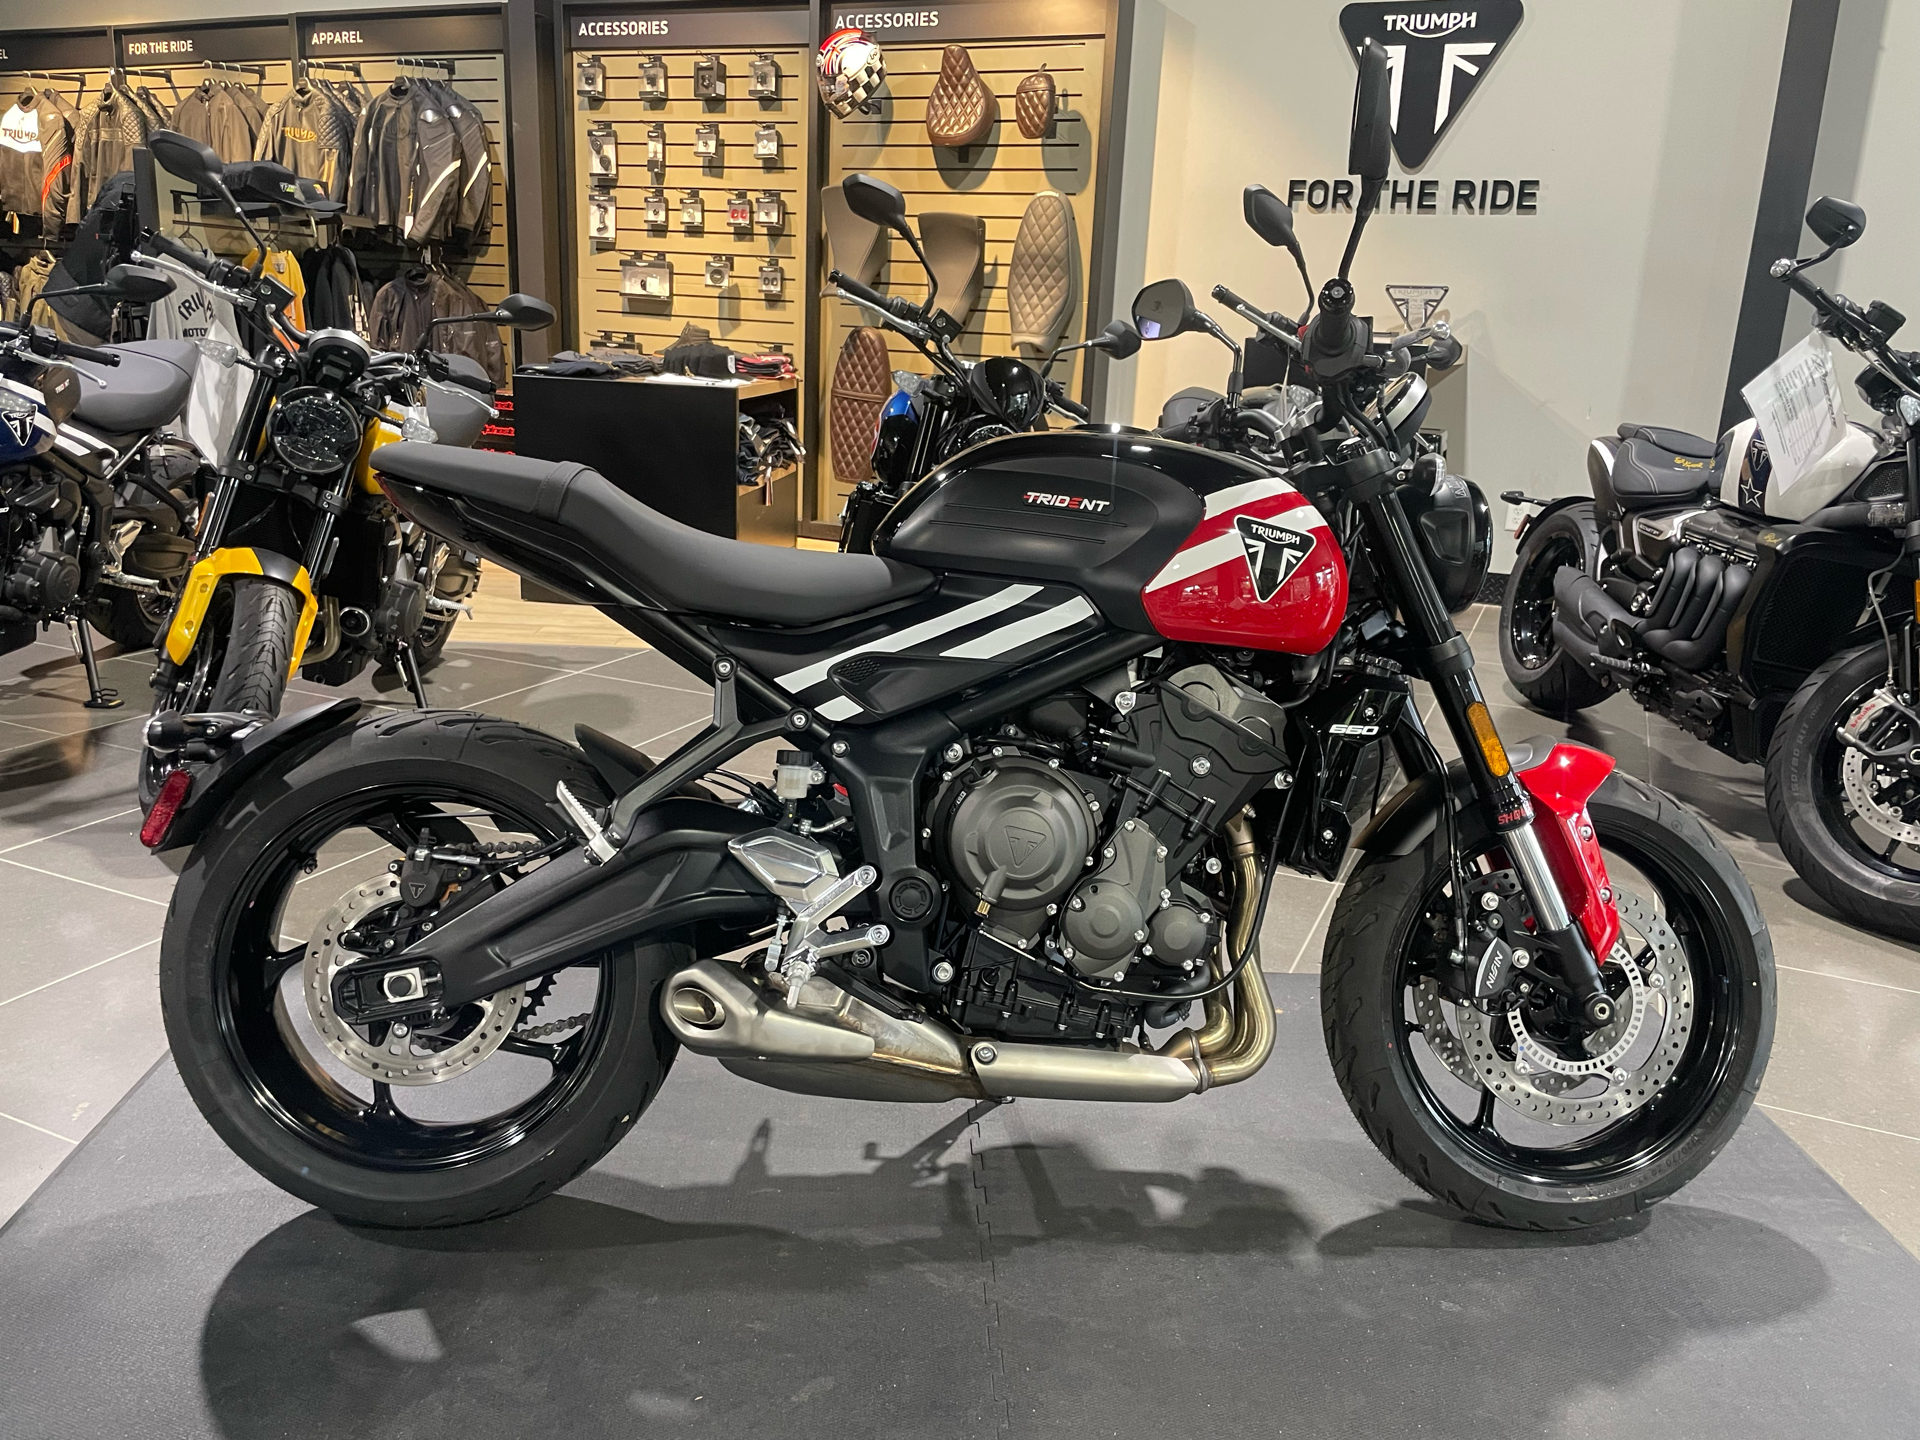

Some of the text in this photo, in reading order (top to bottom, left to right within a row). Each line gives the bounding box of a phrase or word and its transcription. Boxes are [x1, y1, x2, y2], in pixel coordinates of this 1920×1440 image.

[578, 20, 669, 36] ACCESSORIES
[835, 11, 939, 30] ACCESSORIES
[1384, 12, 1477, 38] TRIUMPH
[311, 31, 364, 45] APPAREL
[128, 40, 194, 55] FOR THE RIDE
[2, 127, 37, 144] TRIUMP
[1287, 179, 1354, 212] FOR
[1452, 179, 1540, 212] RIDE
[182, 327, 208, 338] MOTO
[1023, 491, 1110, 512] TRIDENT
[1251, 523, 1300, 545] TRIUMPH
[1329, 724, 1379, 735] 660
[1497, 808, 1526, 825] SHO
[1486, 950, 1504, 989] NISSIN
